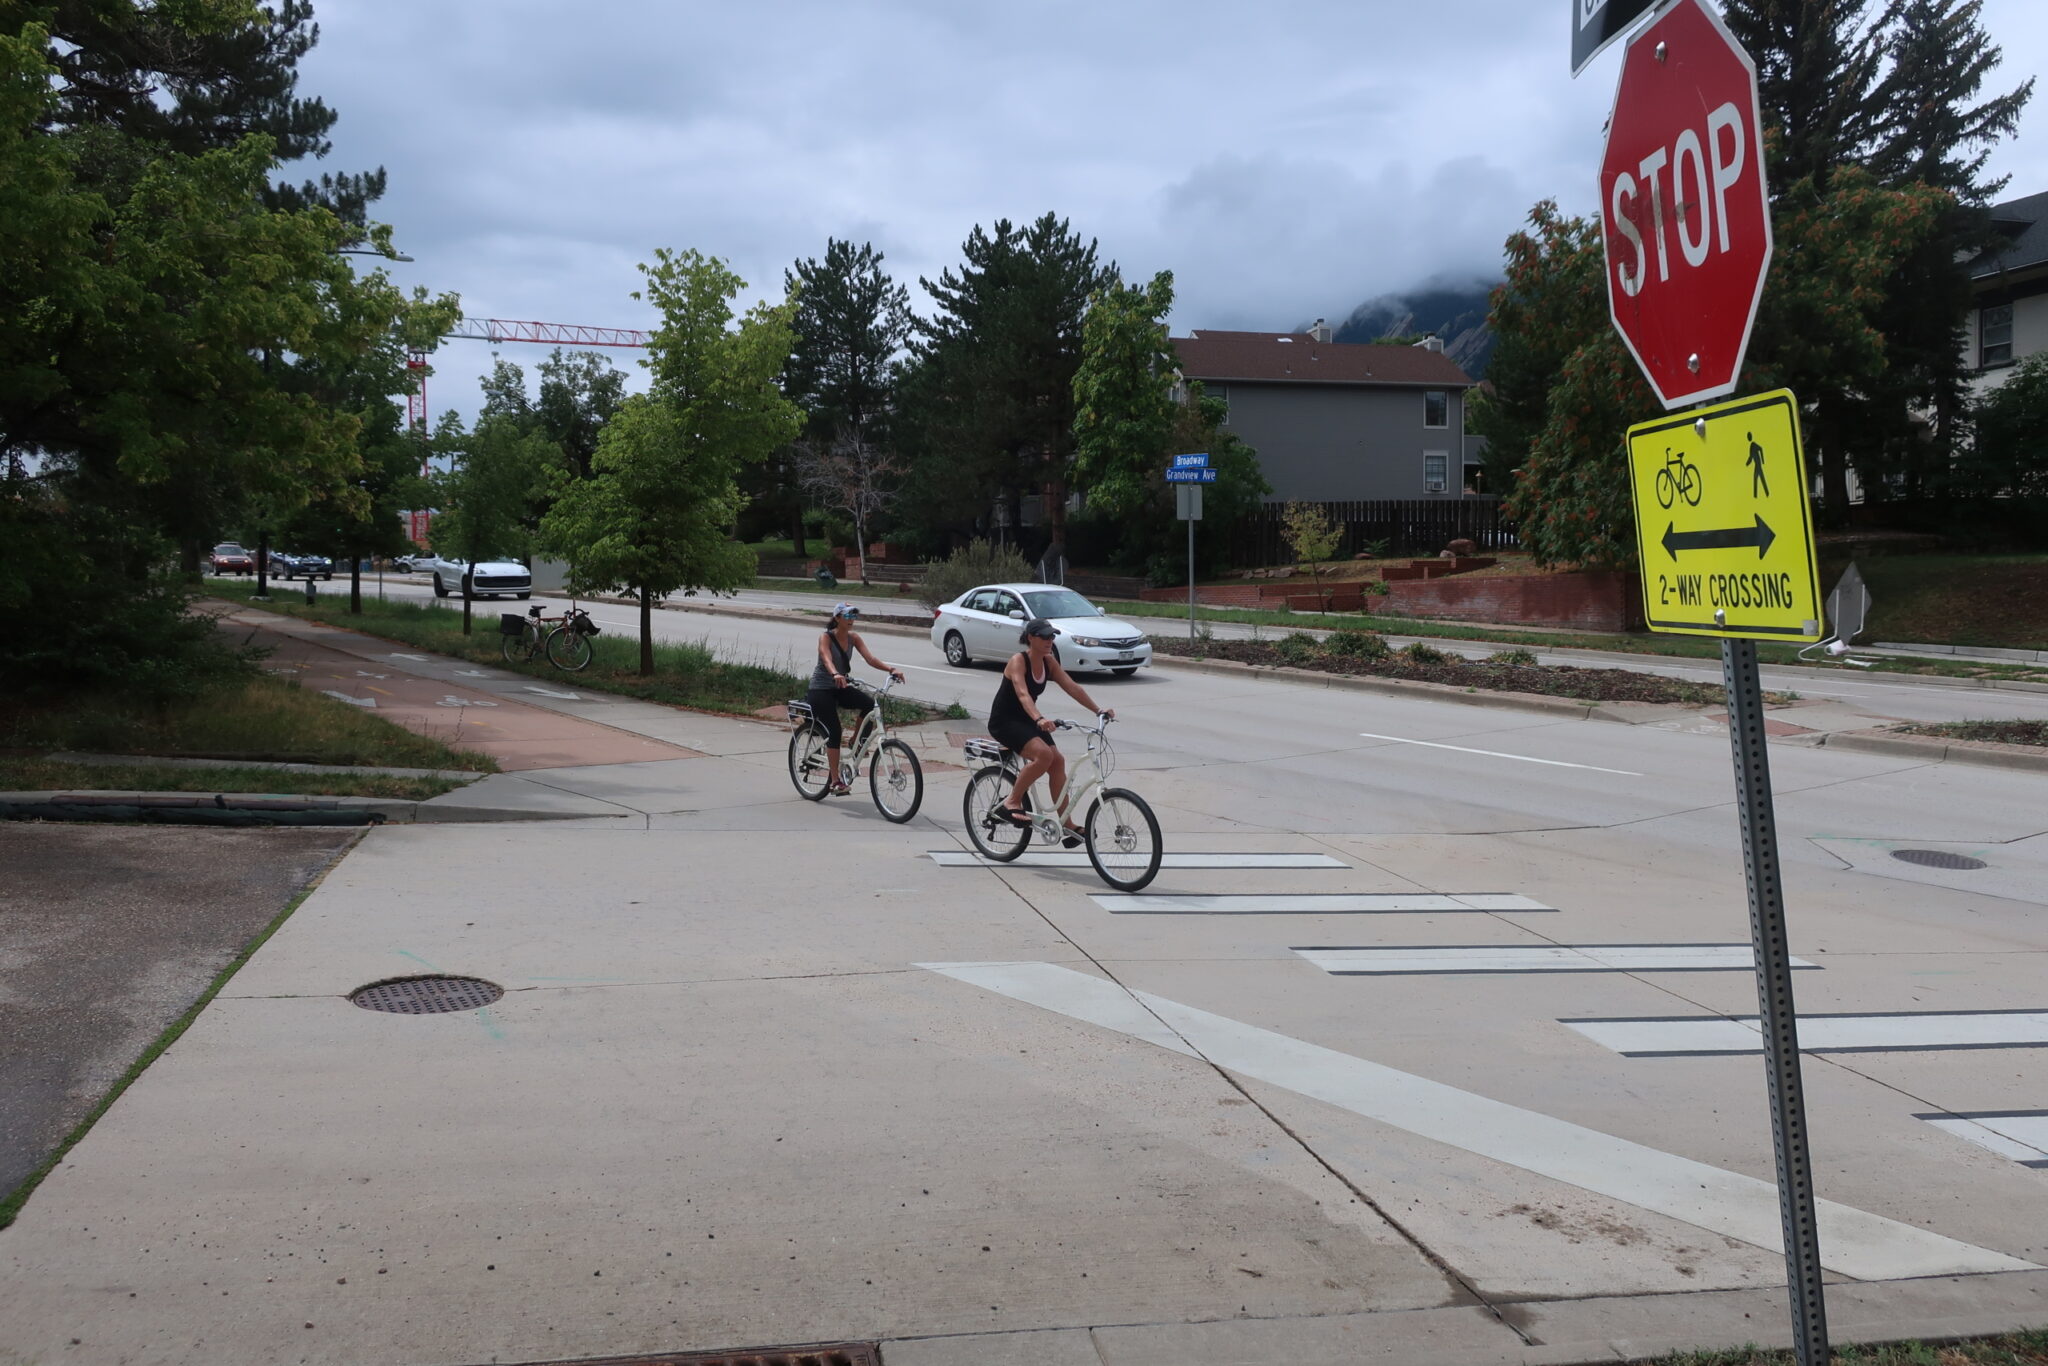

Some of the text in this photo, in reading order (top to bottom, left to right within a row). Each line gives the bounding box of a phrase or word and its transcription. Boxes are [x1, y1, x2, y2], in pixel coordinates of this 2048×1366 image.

[1612, 102, 1745, 297] STOP
[1177, 456, 1205, 466] Broadway
[1166, 469, 1216, 480] Grandview Ave
[1659, 572, 1793, 609] 2-WAY CROSSING
